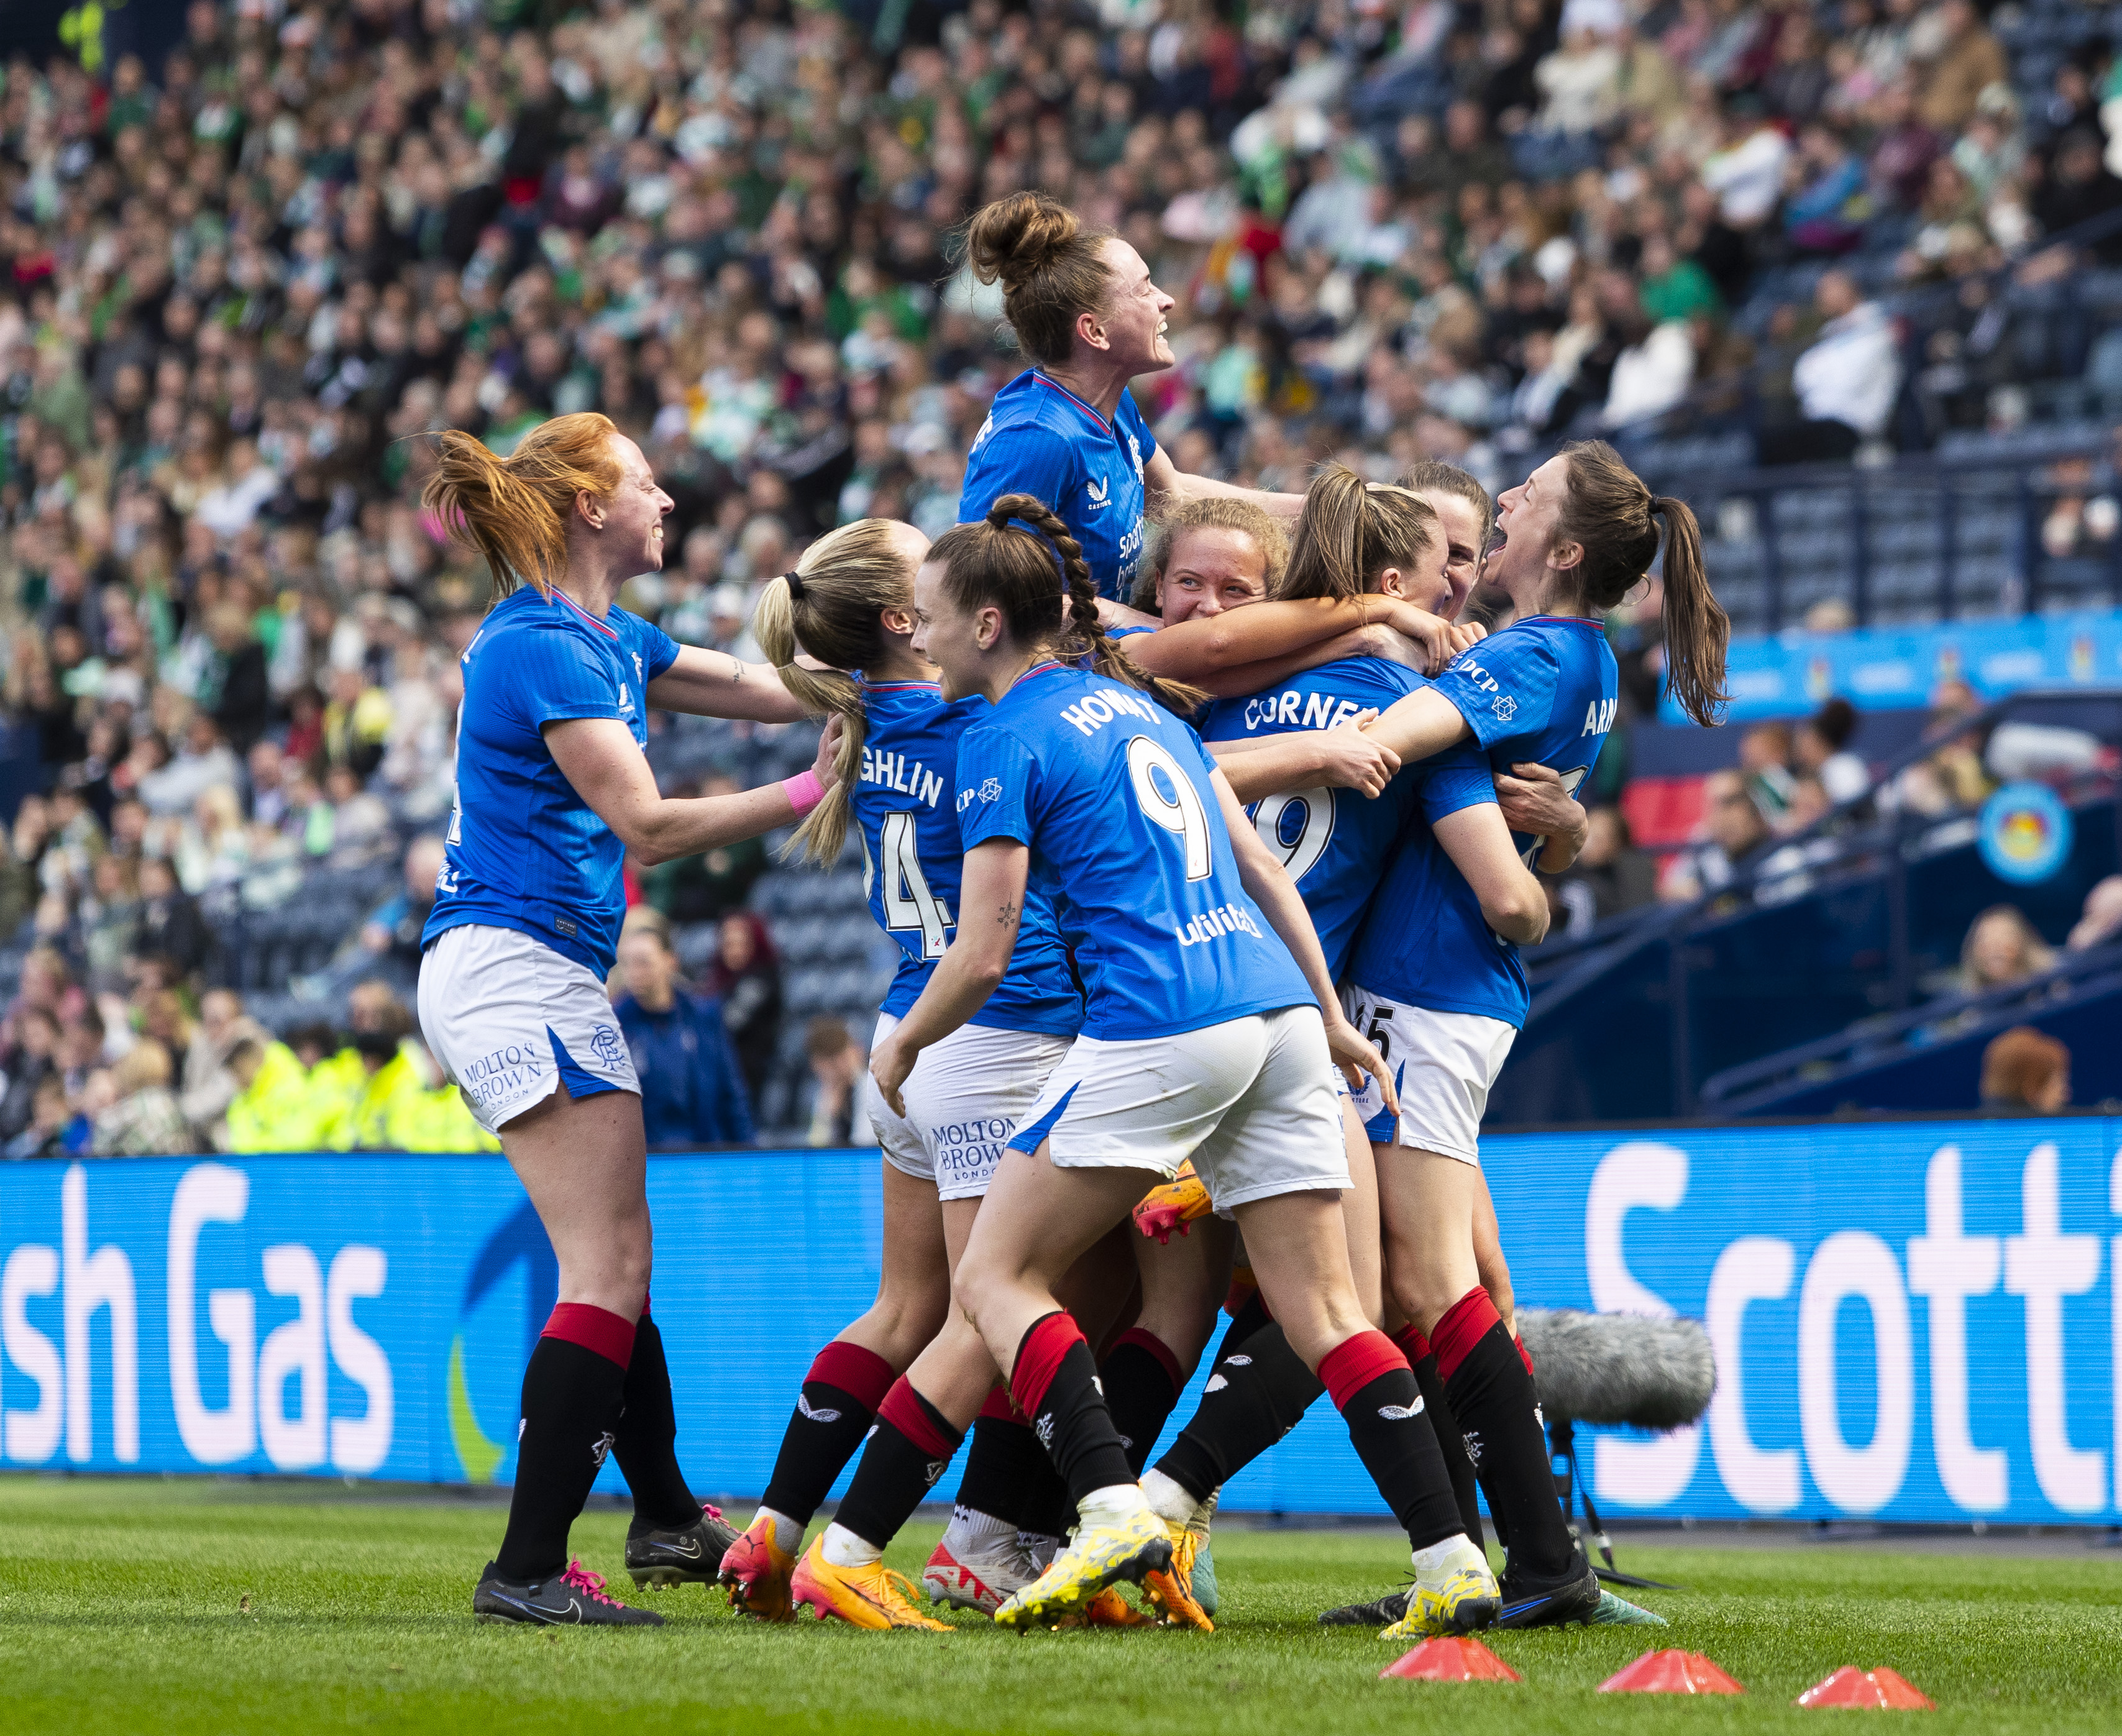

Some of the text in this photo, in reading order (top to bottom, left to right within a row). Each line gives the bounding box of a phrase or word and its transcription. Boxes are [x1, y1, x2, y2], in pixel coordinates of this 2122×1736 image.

[1458, 659, 1499, 692] DCP
[1060, 688, 1161, 737] HOWAT
[1245, 690, 1380, 731] CORNE
[1127, 734, 1212, 882] 9
[1242, 785, 1336, 885] 9
[470, 1062, 541, 1108] BROWN
[488, 1089, 529, 1113] LONDON
[167, 1163, 395, 1472] Gas
